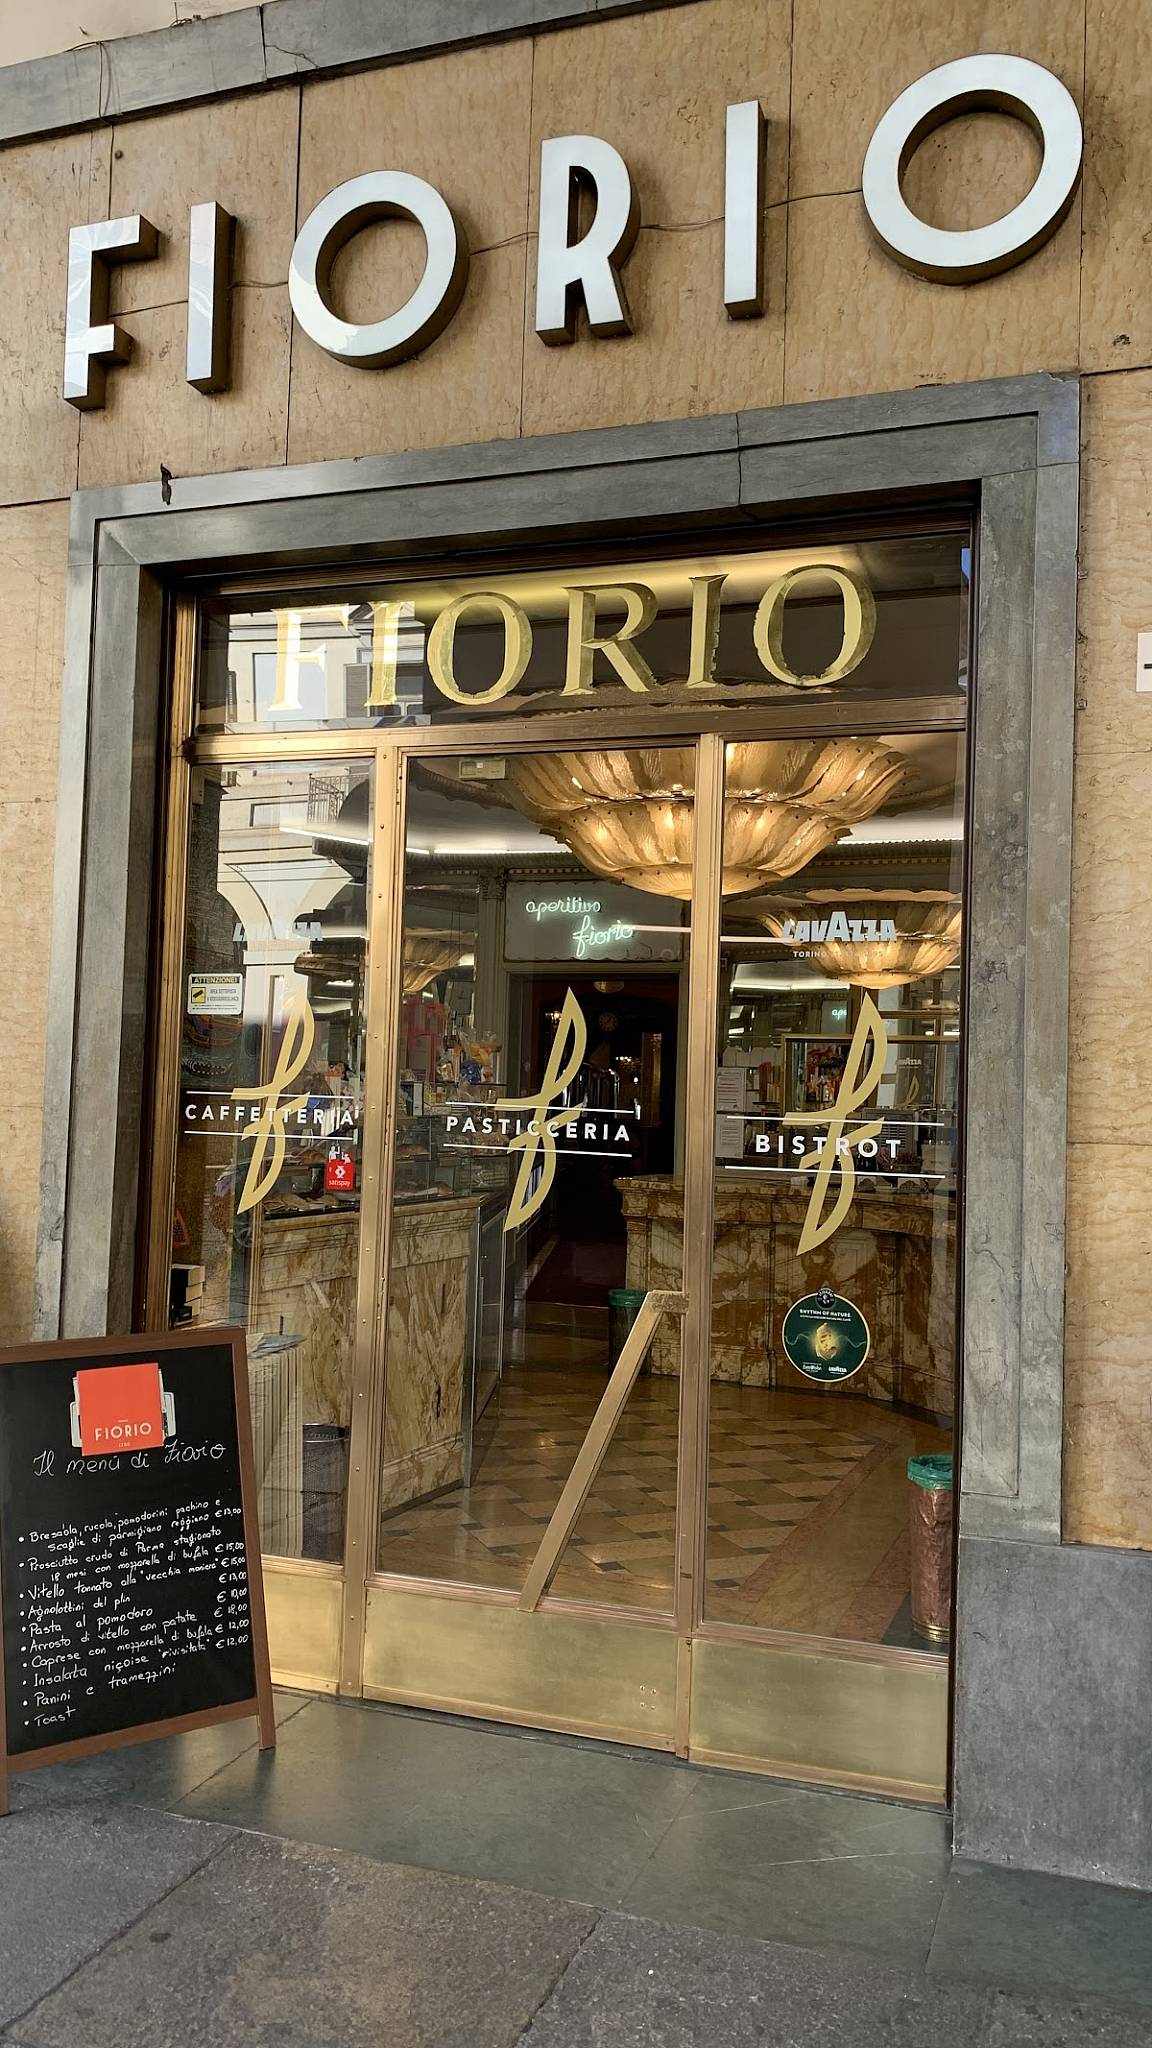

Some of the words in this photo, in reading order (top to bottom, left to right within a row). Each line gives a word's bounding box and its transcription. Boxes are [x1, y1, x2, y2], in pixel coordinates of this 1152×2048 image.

[63, 52, 1084, 411] FIORIO
[271, 563, 876, 713] FIORIO
[525, 896, 601, 922] aperitivo
[572, 915, 635, 957] fiorio
[783, 911, 898, 942] LAVAZZA
[445, 1116, 631, 1142] PASTICCERIA
[755, 1134, 902, 1159] BISTROT
[95, 1422, 152, 1441] FIORIO
[33, 1450, 55, 1477] Il
[130, 1451, 150, 1469] di
[164, 1438, 227, 1464] Fiorio
[176, 1501, 209, 1519] pachino
[27, 1554, 78, 1571] Prosciutto
[85, 1549, 112, 1562] crudo
[119, 1547, 128, 1557] di
[135, 1541, 165, 1554] Parma
[173, 1525, 221, 1547] stagionato
[47, 1536, 86, 1552] scaglie
[92, 1532, 101, 1543] di
[108, 1525, 162, 1547] parmigiano
[171, 1514, 209, 1531] reggiano
[66, 1568, 87, 1580] mesi
[95, 1565, 111, 1574] con
[118, 1553, 160, 1570] mozzarella
[167, 1550, 176, 1561] di
[183, 1545, 209, 1561] bufala
[28, 1583, 65, 1600] Vitello
[120, 1569, 136, 1586] alla
[27, 1601, 85, 1622] Agnolottini
[93, 1595, 107, 1608] del
[114, 1592, 130, 1610] plin
[28, 1619, 62, 1637] Pasta
[75, 1613, 86, 1628] al
[97, 1606, 153, 1631] pomodoro
[29, 1634, 71, 1653] Arrosto
[80, 1630, 90, 1643] di
[98, 1624, 130, 1640] vitello
[139, 1623, 157, 1632] con
[162, 1610, 198, 1634] patate
[31, 1652, 81, 1673] Caprese
[88, 1647, 107, 1656] con
[117, 1634, 164, 1653] mozzarella
[171, 1629, 179, 1641] di
[186, 1624, 213, 1640] bufala
[33, 1663, 88, 1687] Insalata
[104, 1655, 149, 1673] niçoise
[34, 1689, 71, 1707] Panini
[86, 1686, 95, 1695] e
[108, 1662, 176, 1689] tramezzini
[33, 1705, 77, 1727] Toast
